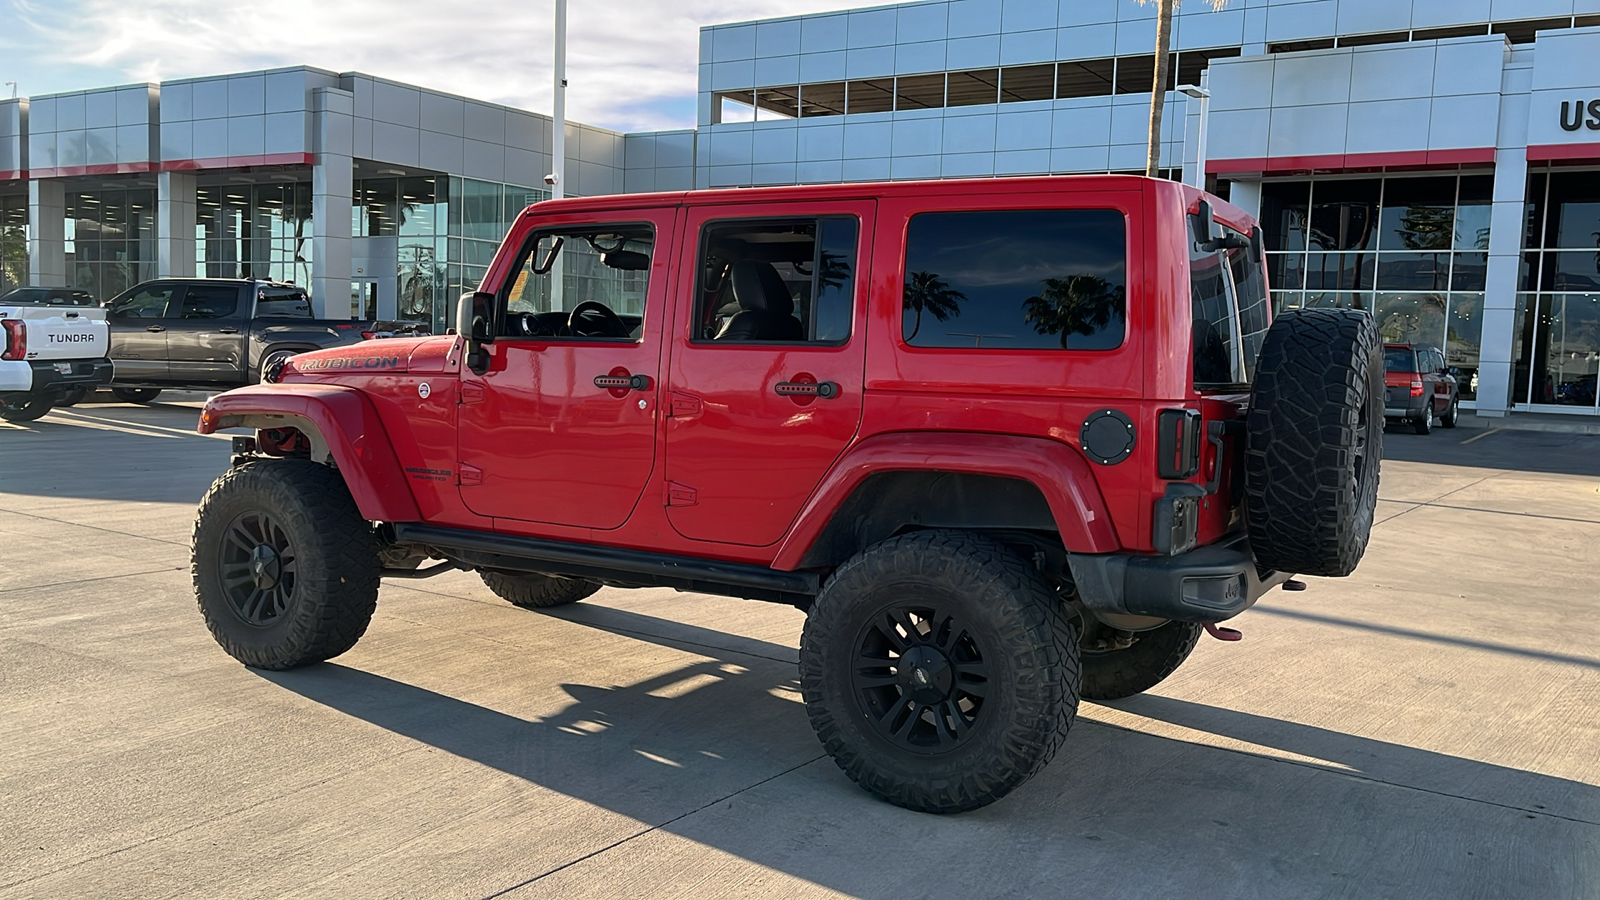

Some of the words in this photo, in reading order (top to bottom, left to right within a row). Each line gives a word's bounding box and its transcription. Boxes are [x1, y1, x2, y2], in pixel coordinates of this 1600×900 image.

[1560, 98, 1600, 131] US
[48, 334, 95, 343] TUNDRA
[301, 356, 399, 371] RUBICON
